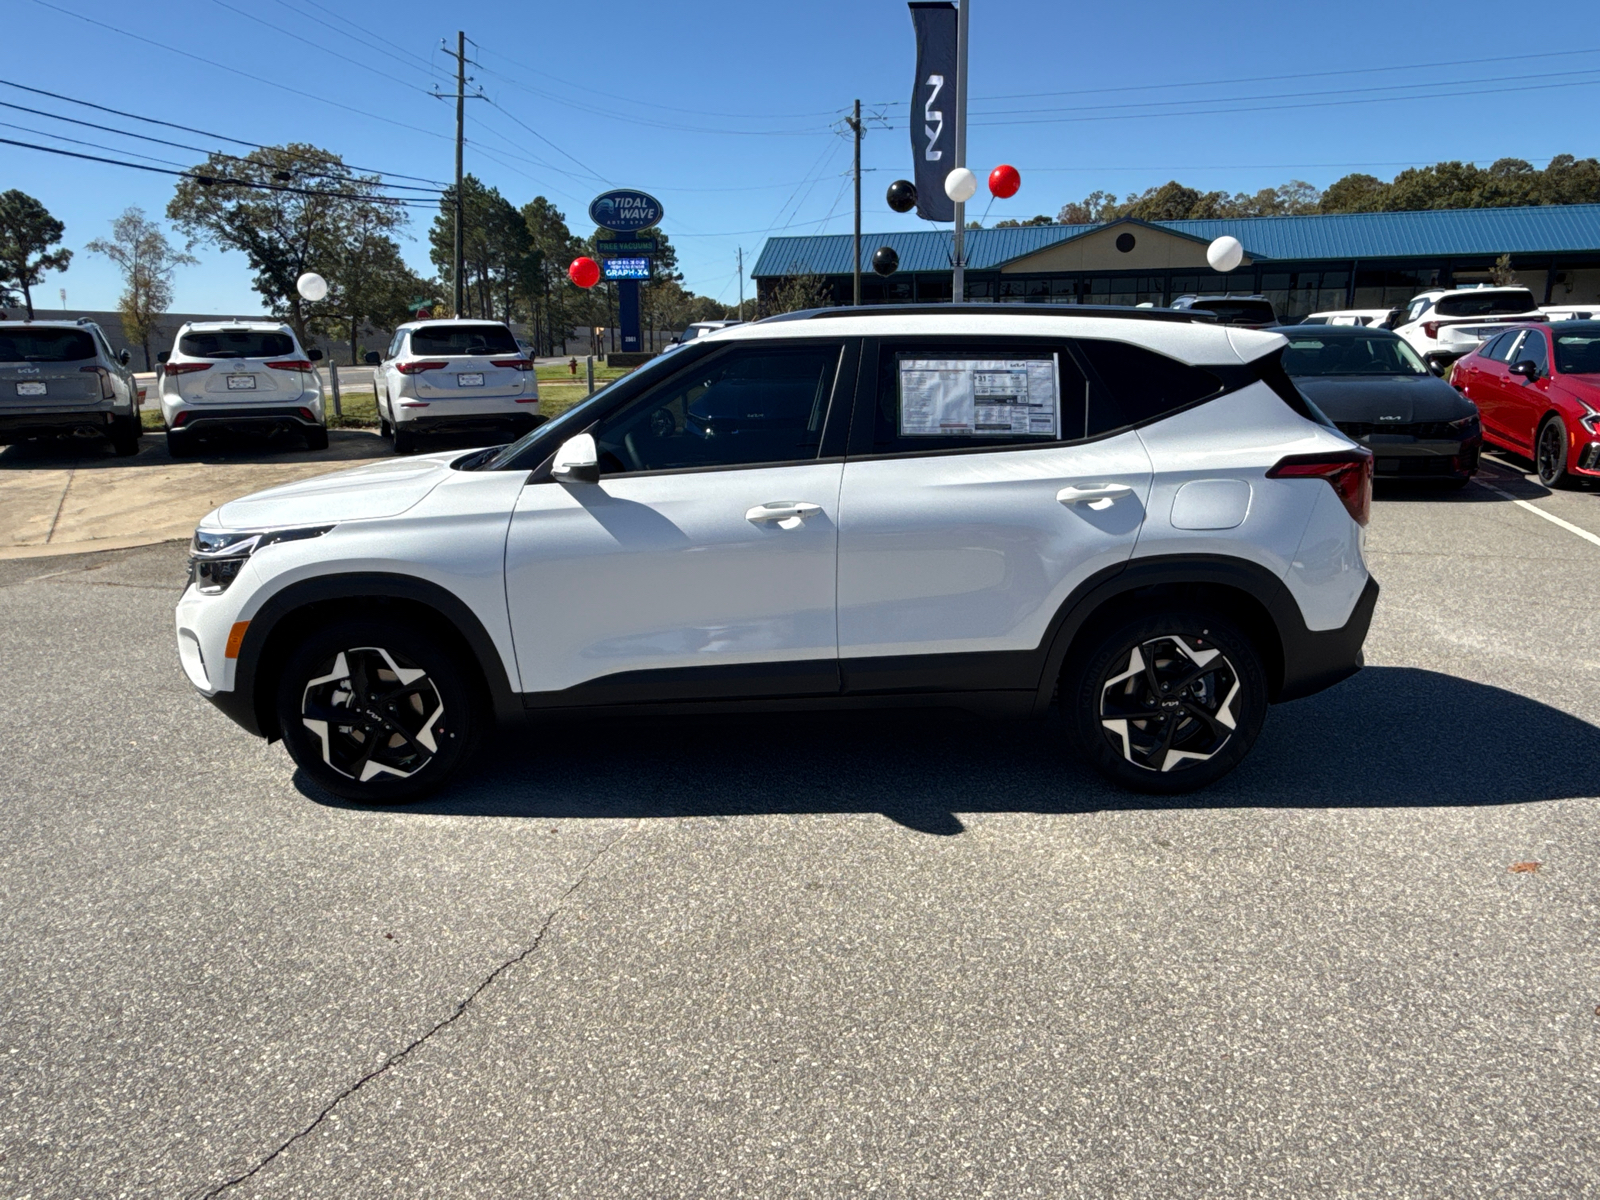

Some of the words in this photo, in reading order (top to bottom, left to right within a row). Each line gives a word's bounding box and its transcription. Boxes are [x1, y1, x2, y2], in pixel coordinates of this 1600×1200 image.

[614, 197, 648, 208] TIDAL
[620, 208, 655, 219] WAVE
[599, 242, 618, 250] FREE
[619, 241, 653, 250] VACUUMS
[1081, 651, 1111, 709] KUMHO
